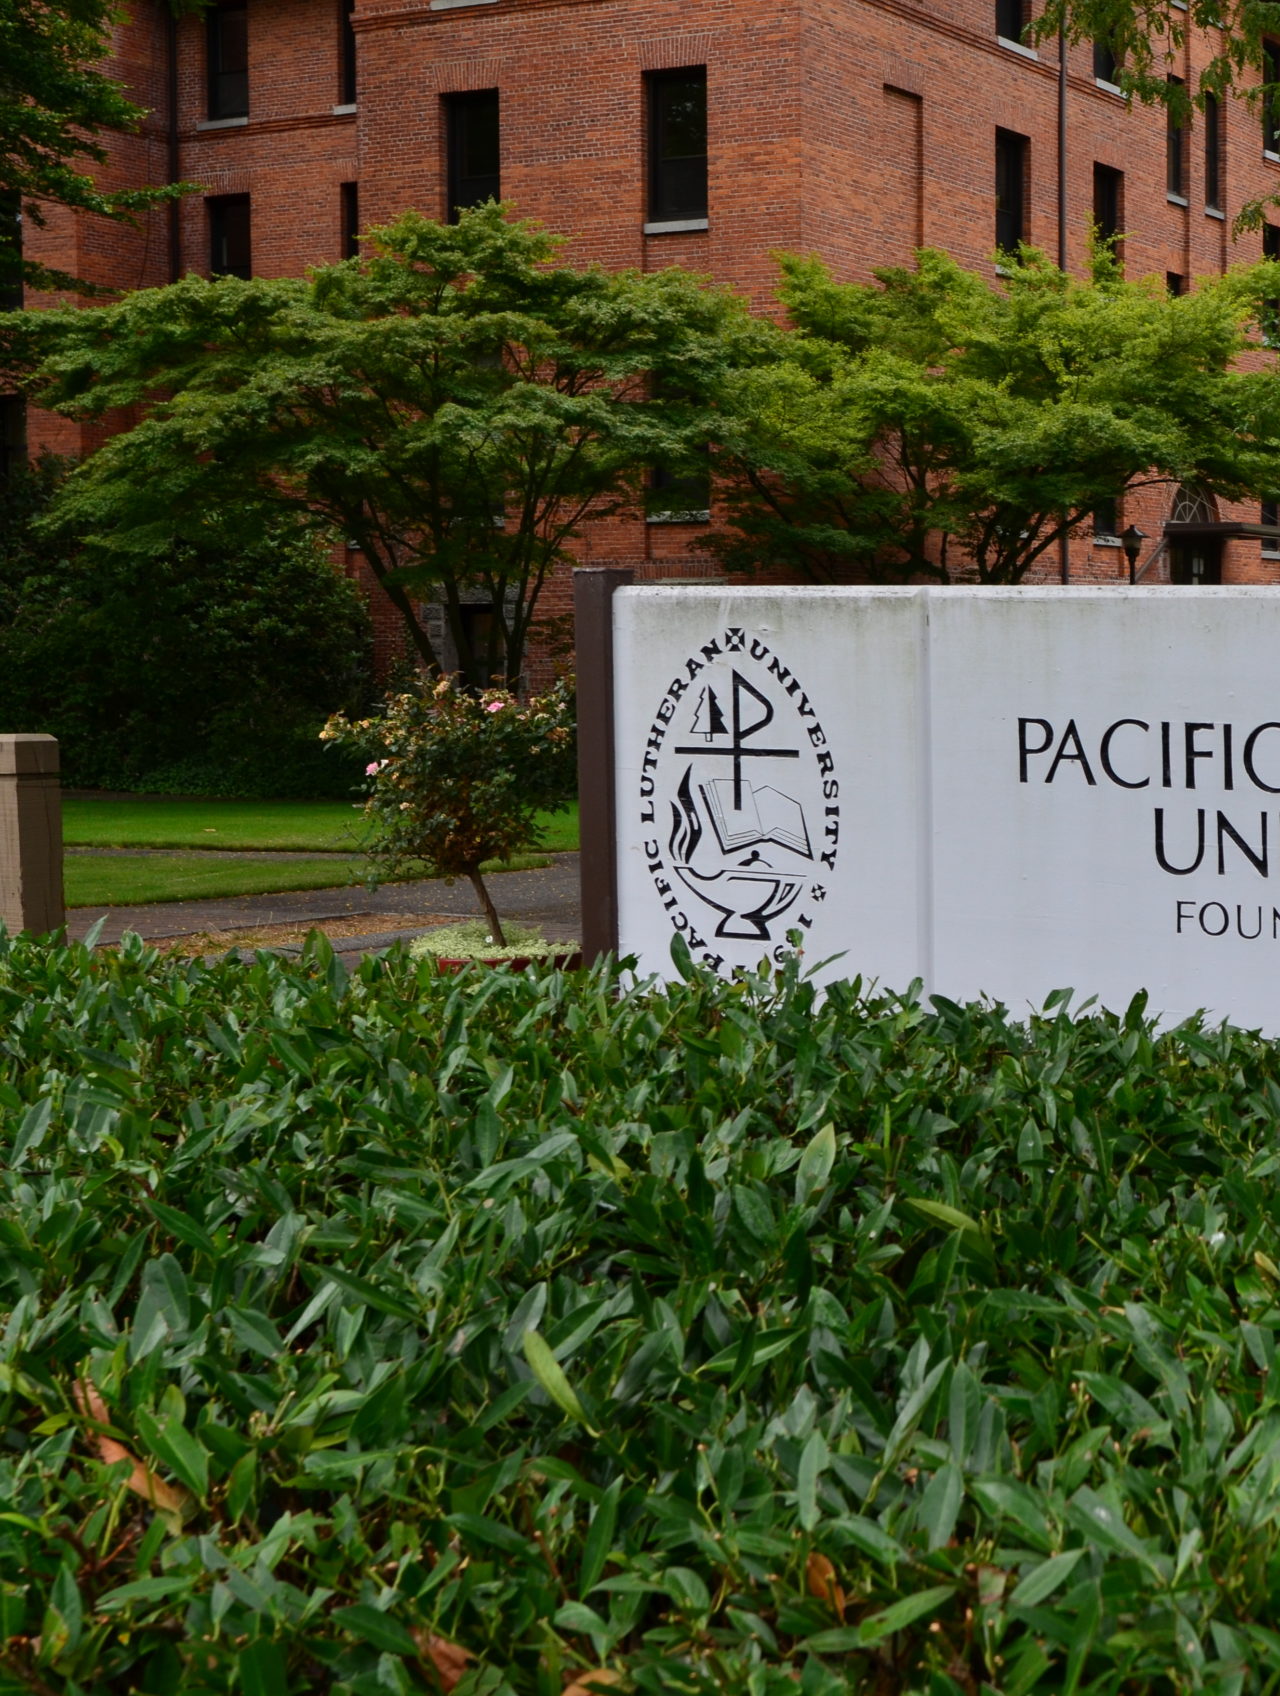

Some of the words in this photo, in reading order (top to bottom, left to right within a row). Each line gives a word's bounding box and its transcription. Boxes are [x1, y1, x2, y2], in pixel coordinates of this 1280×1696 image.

[640, 638, 722, 824] LUTHERAN
[749, 638, 840, 872] UNIVERSITY
[644, 839, 724, 973] PACIFIC
